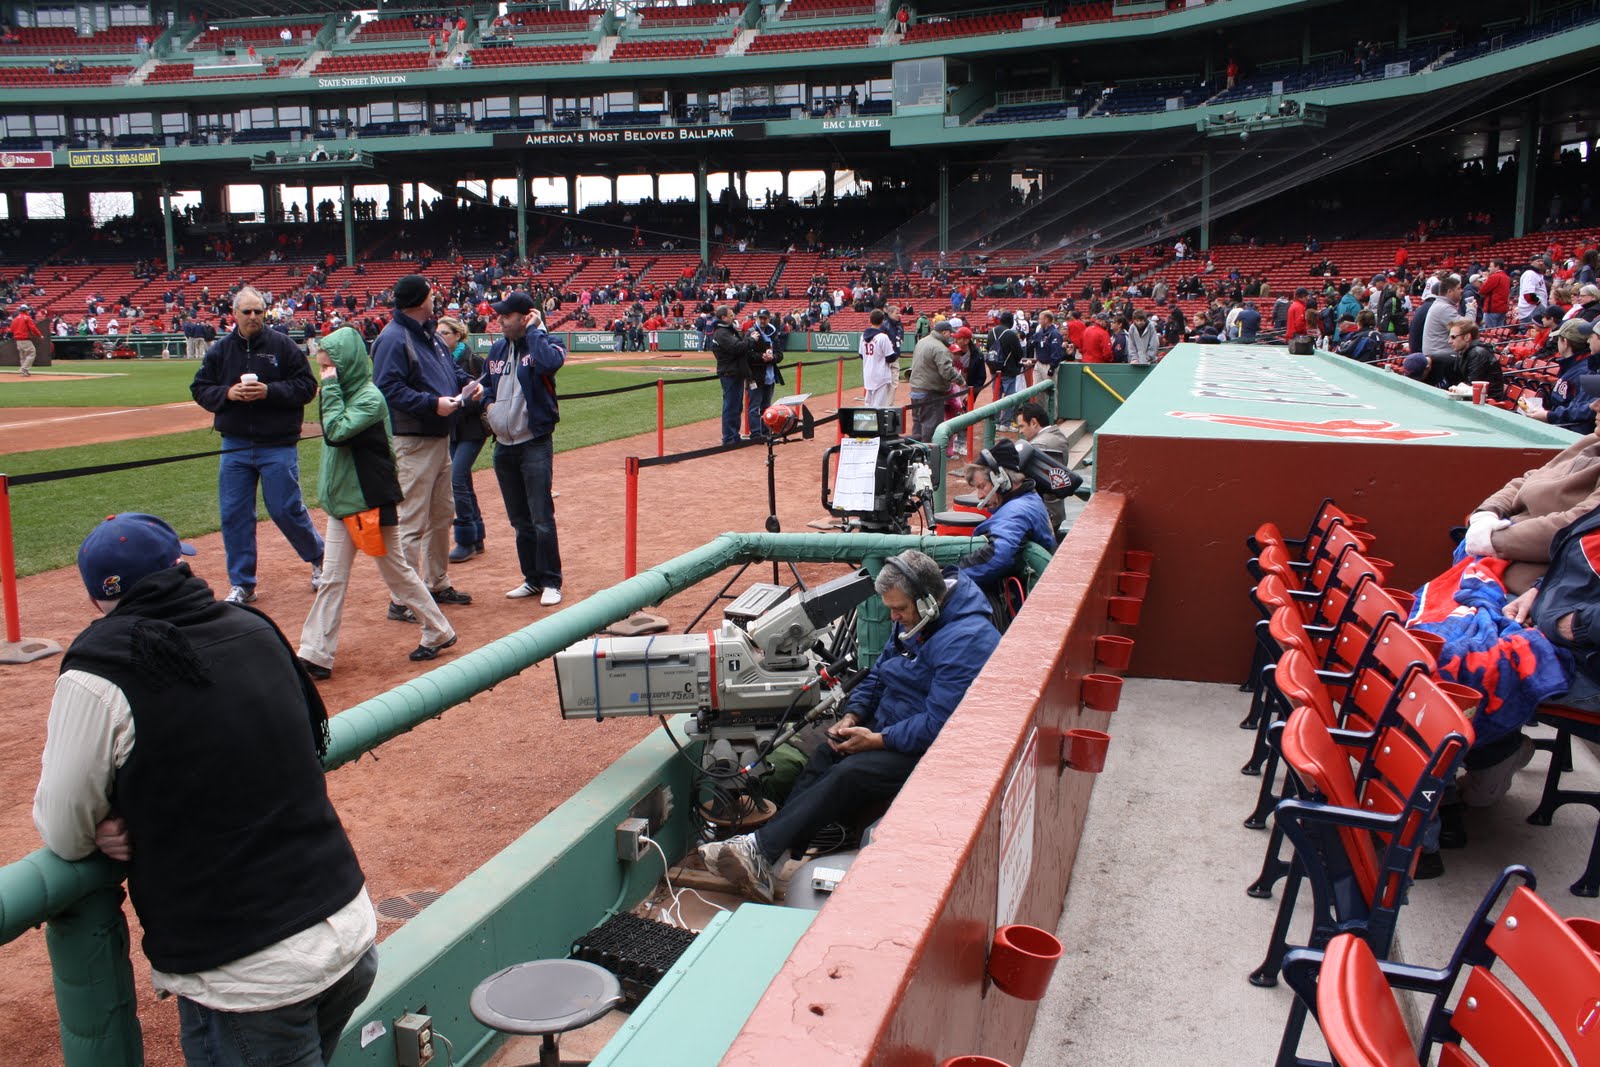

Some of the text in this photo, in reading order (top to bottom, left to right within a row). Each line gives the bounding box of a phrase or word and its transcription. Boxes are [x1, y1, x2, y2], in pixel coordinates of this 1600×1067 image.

[318, 78, 340, 88] STATE
[370, 75, 406, 85] PAVILION
[823, 119, 882, 129] EMC LEVEL
[525, 128, 734, 145] AMERICA'S MOST BELOVED BALLPARK
[15, 156, 35, 164] Nine
[72, 154, 92, 165] GIANT
[93, 153, 114, 165] GLASS
[138, 152, 156, 163] GIANT
[815, 334, 850, 346] WM
[684, 682, 692, 693] C
[671, 690, 683, 701] 75
[1422, 790, 1436, 802] A
